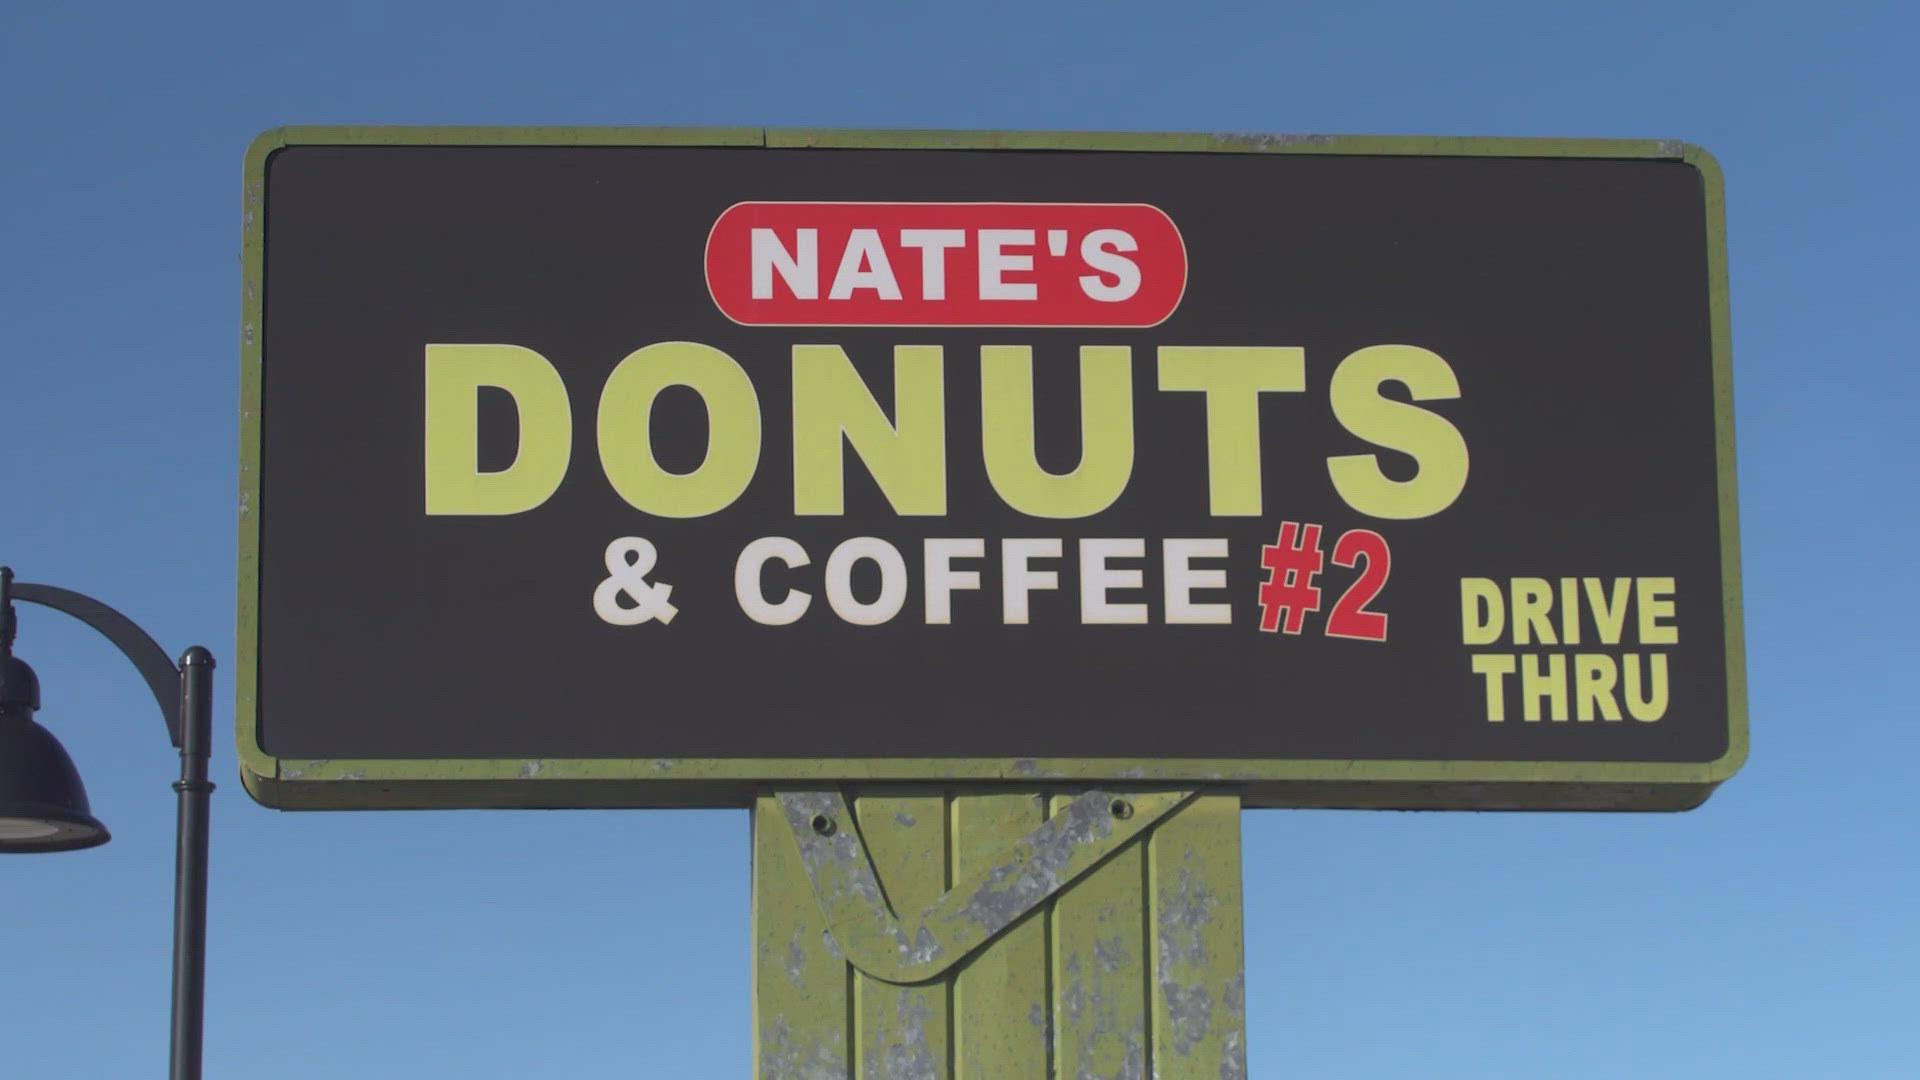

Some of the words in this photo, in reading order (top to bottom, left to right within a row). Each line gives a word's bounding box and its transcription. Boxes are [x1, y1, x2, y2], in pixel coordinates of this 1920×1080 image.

[749, 228, 1142, 302] NATE'S
[423, 341, 1470, 521] DONUTS
[593, 536, 678, 626] &
[735, 536, 1232, 626] COFFEE
[1258, 520, 1392, 642] #2
[1460, 576, 1679, 645] DRIVE
[1471, 653, 1670, 723] THRU
